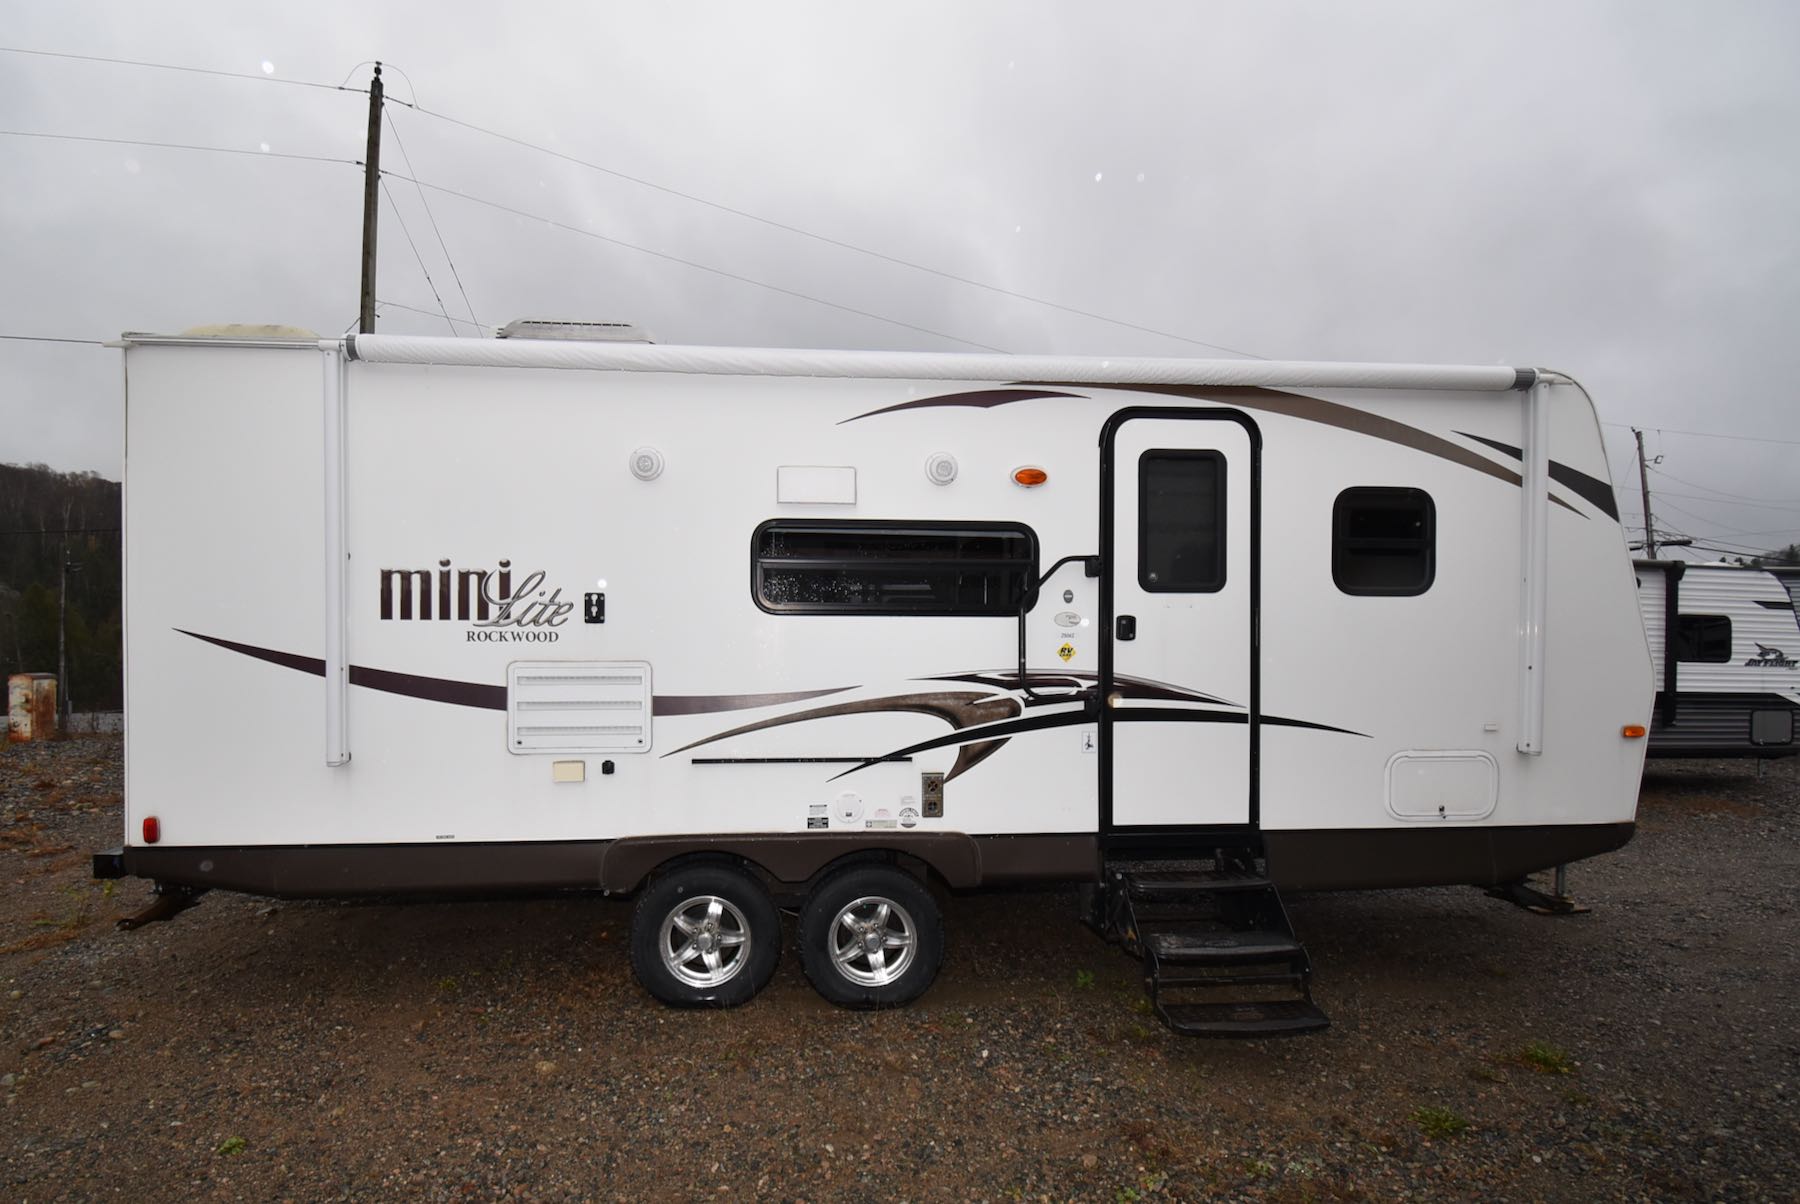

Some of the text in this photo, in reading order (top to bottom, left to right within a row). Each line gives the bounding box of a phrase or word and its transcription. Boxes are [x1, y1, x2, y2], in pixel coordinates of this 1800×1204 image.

[380, 558, 511, 620] mini
[473, 569, 574, 627] Lite
[466, 630, 559, 642] ROCKWOOD
